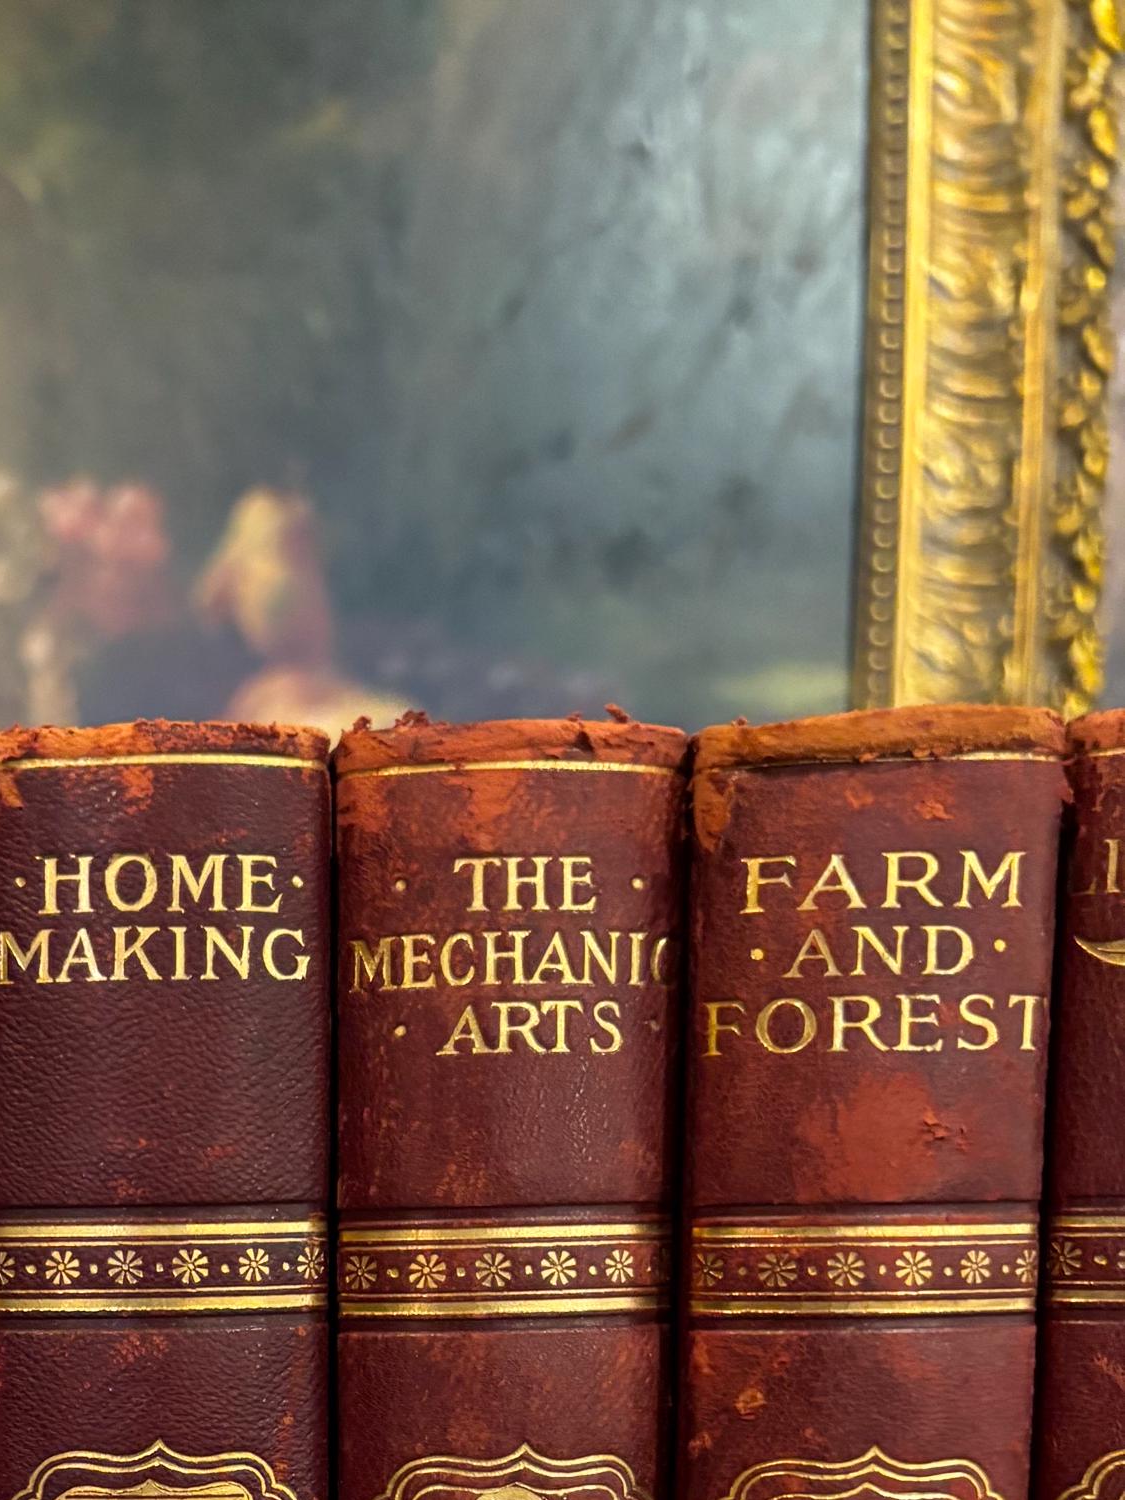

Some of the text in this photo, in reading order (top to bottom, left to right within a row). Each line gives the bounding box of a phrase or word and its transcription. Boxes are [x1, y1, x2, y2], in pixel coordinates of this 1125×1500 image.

[35, 854, 283, 914] HOME
[454, 855, 597, 912] THE
[739, 850, 1027, 914] FARM
[782, 926, 973, 978] AND
[436, 1000, 624, 1056] ARTS
[702, 994, 1047, 1057] FOREST
